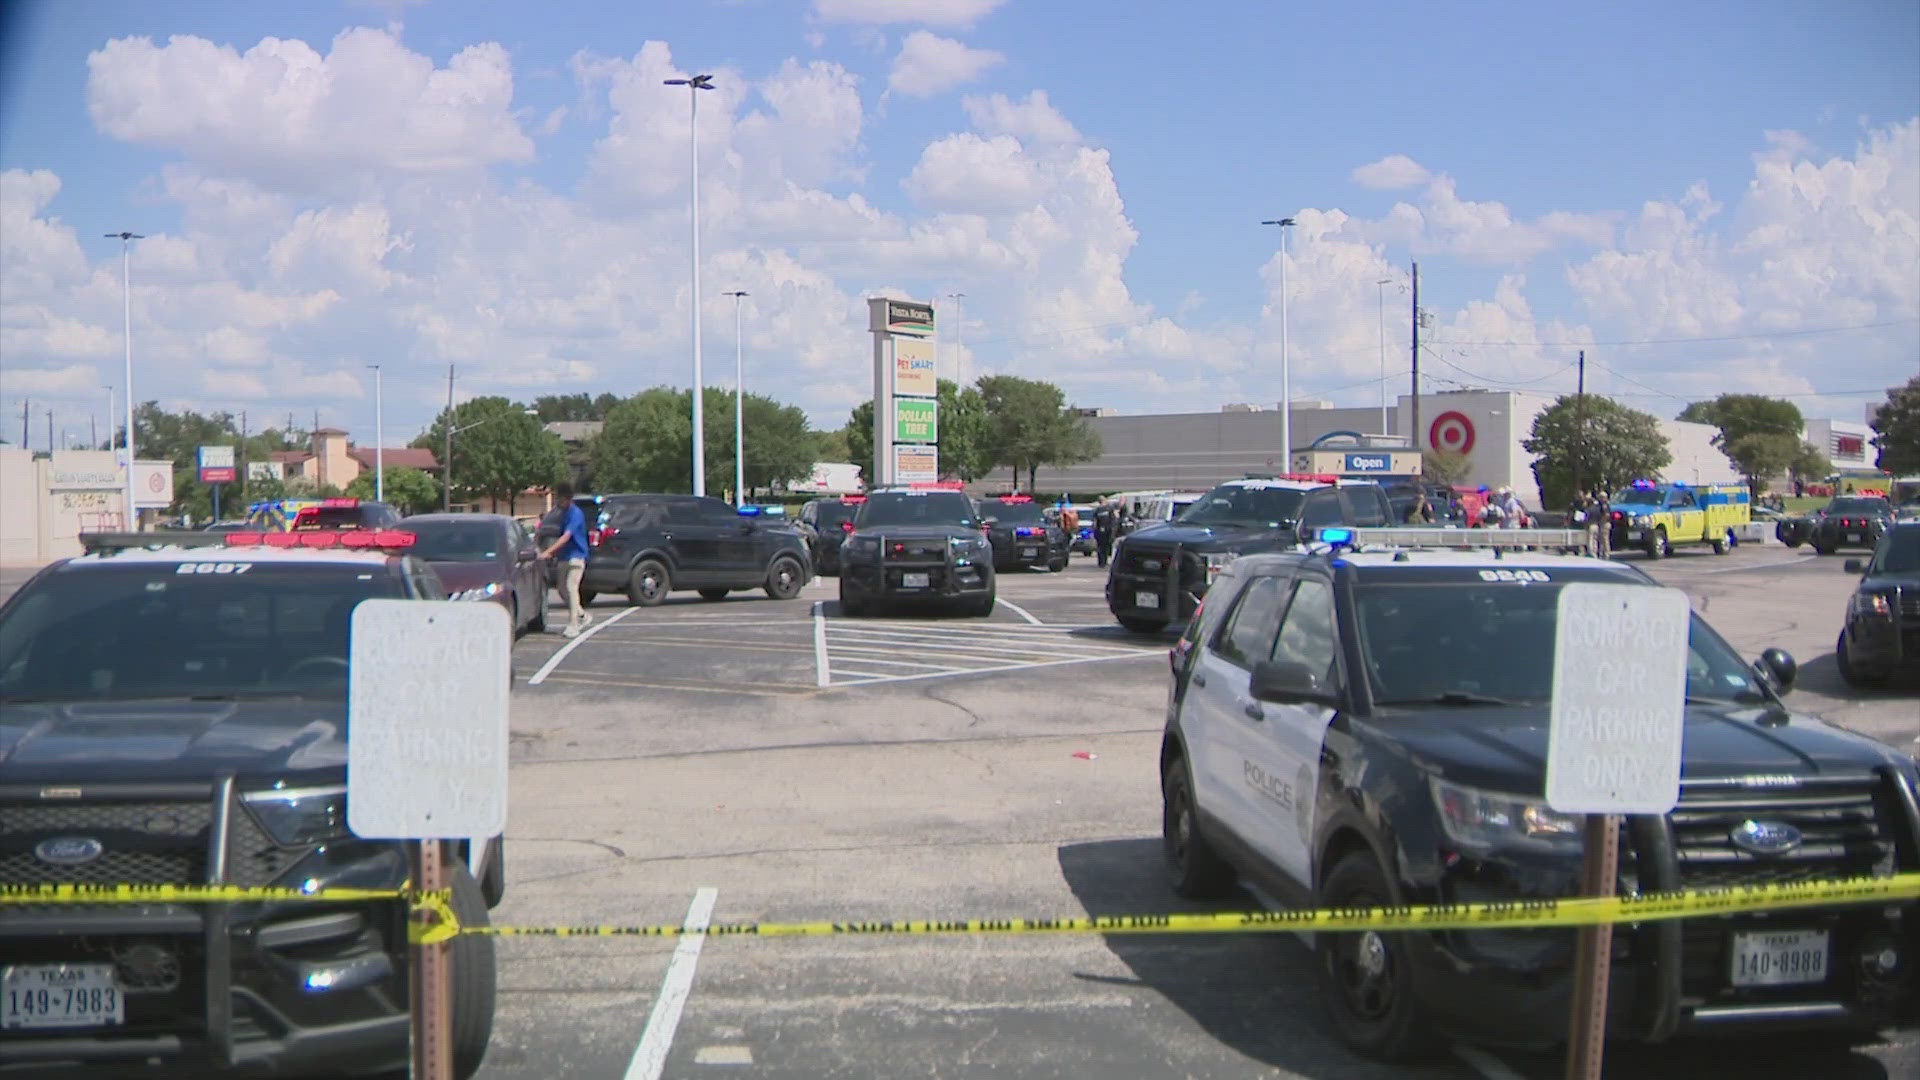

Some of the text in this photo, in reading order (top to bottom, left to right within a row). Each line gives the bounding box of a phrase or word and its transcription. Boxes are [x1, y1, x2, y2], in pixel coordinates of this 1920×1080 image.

[898, 409, 933, 423] DOLLAR
[905, 422, 928, 435] TREE
[1352, 456, 1384, 471] Open
[1566, 610, 1676, 649] COMPACT
[1596, 660, 1648, 695] CAR
[1565, 705, 1671, 743] PARKING
[1243, 759, 1292, 803] POLICE
[1583, 753, 1648, 789] ONLY
[40, 969, 86, 982] TEXAS
